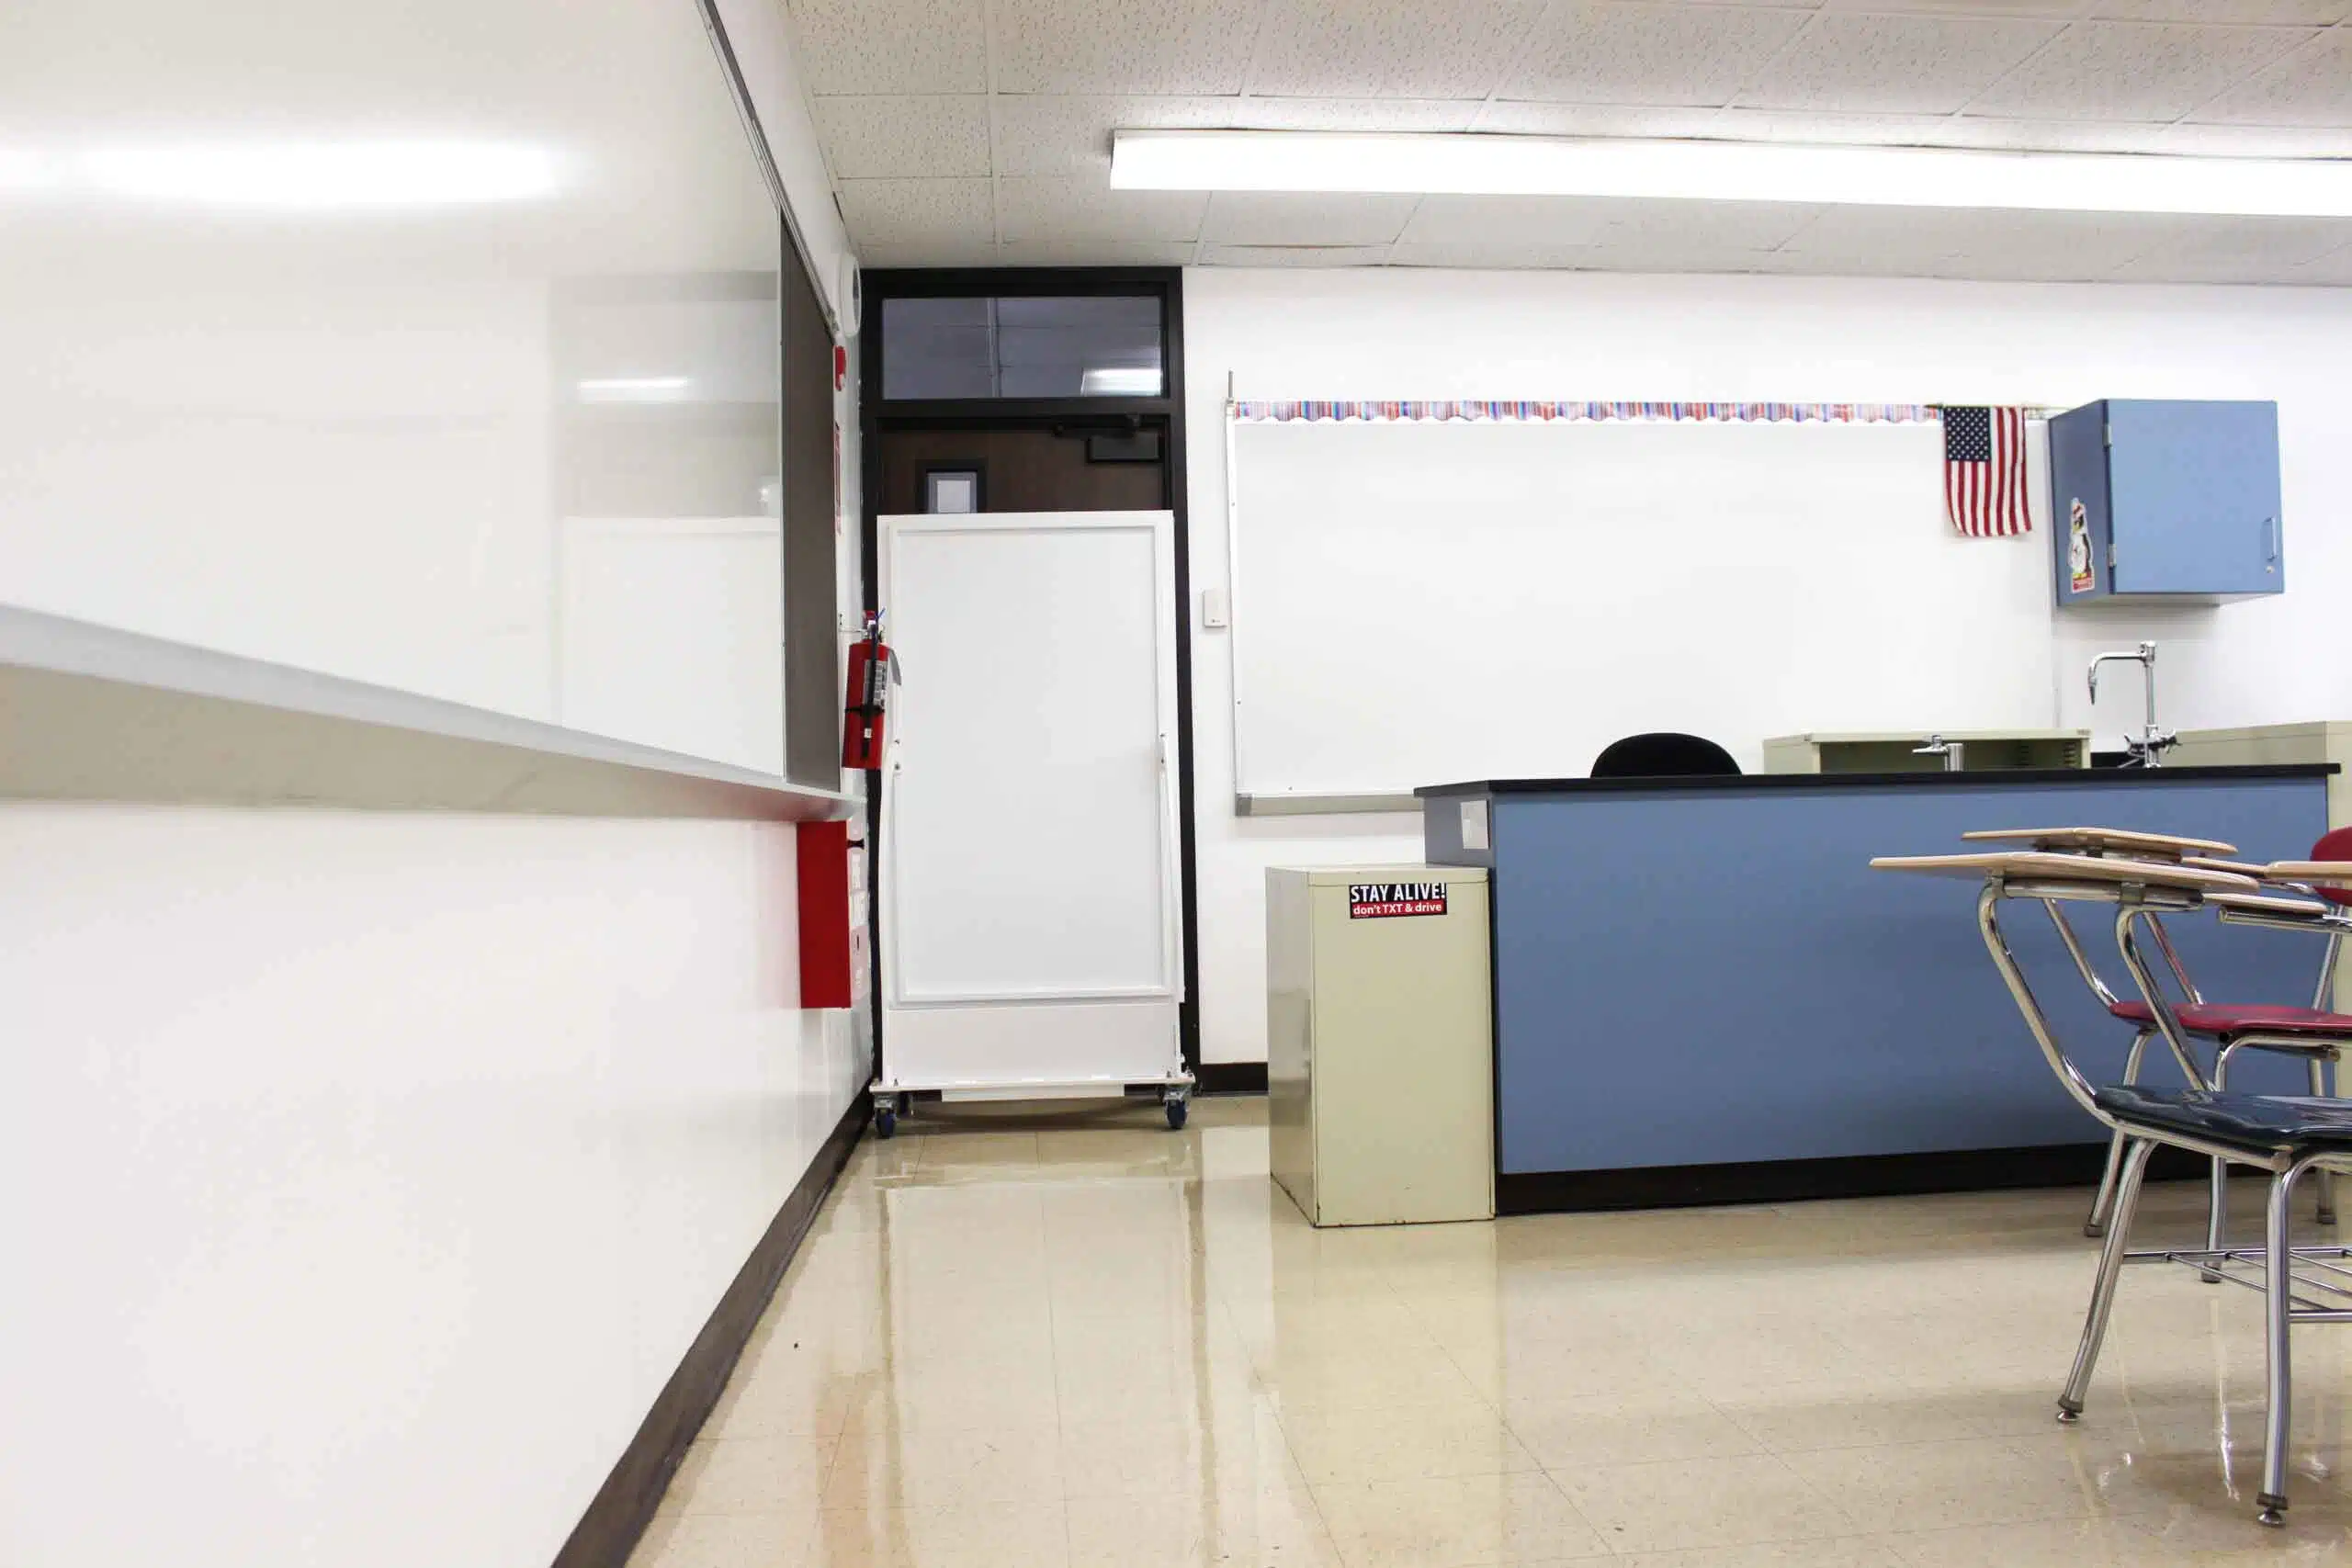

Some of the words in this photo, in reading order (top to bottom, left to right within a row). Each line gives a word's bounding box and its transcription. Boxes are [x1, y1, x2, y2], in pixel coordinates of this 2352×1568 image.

[1351, 885, 1389, 903] STAY
[1394, 883, 1446, 900] ALIVE!
[1353, 905, 1381, 915] don't
[1382, 904, 1404, 913] TXT
[1405, 903, 1413, 913] &
[1415, 902, 1442, 912] drive
